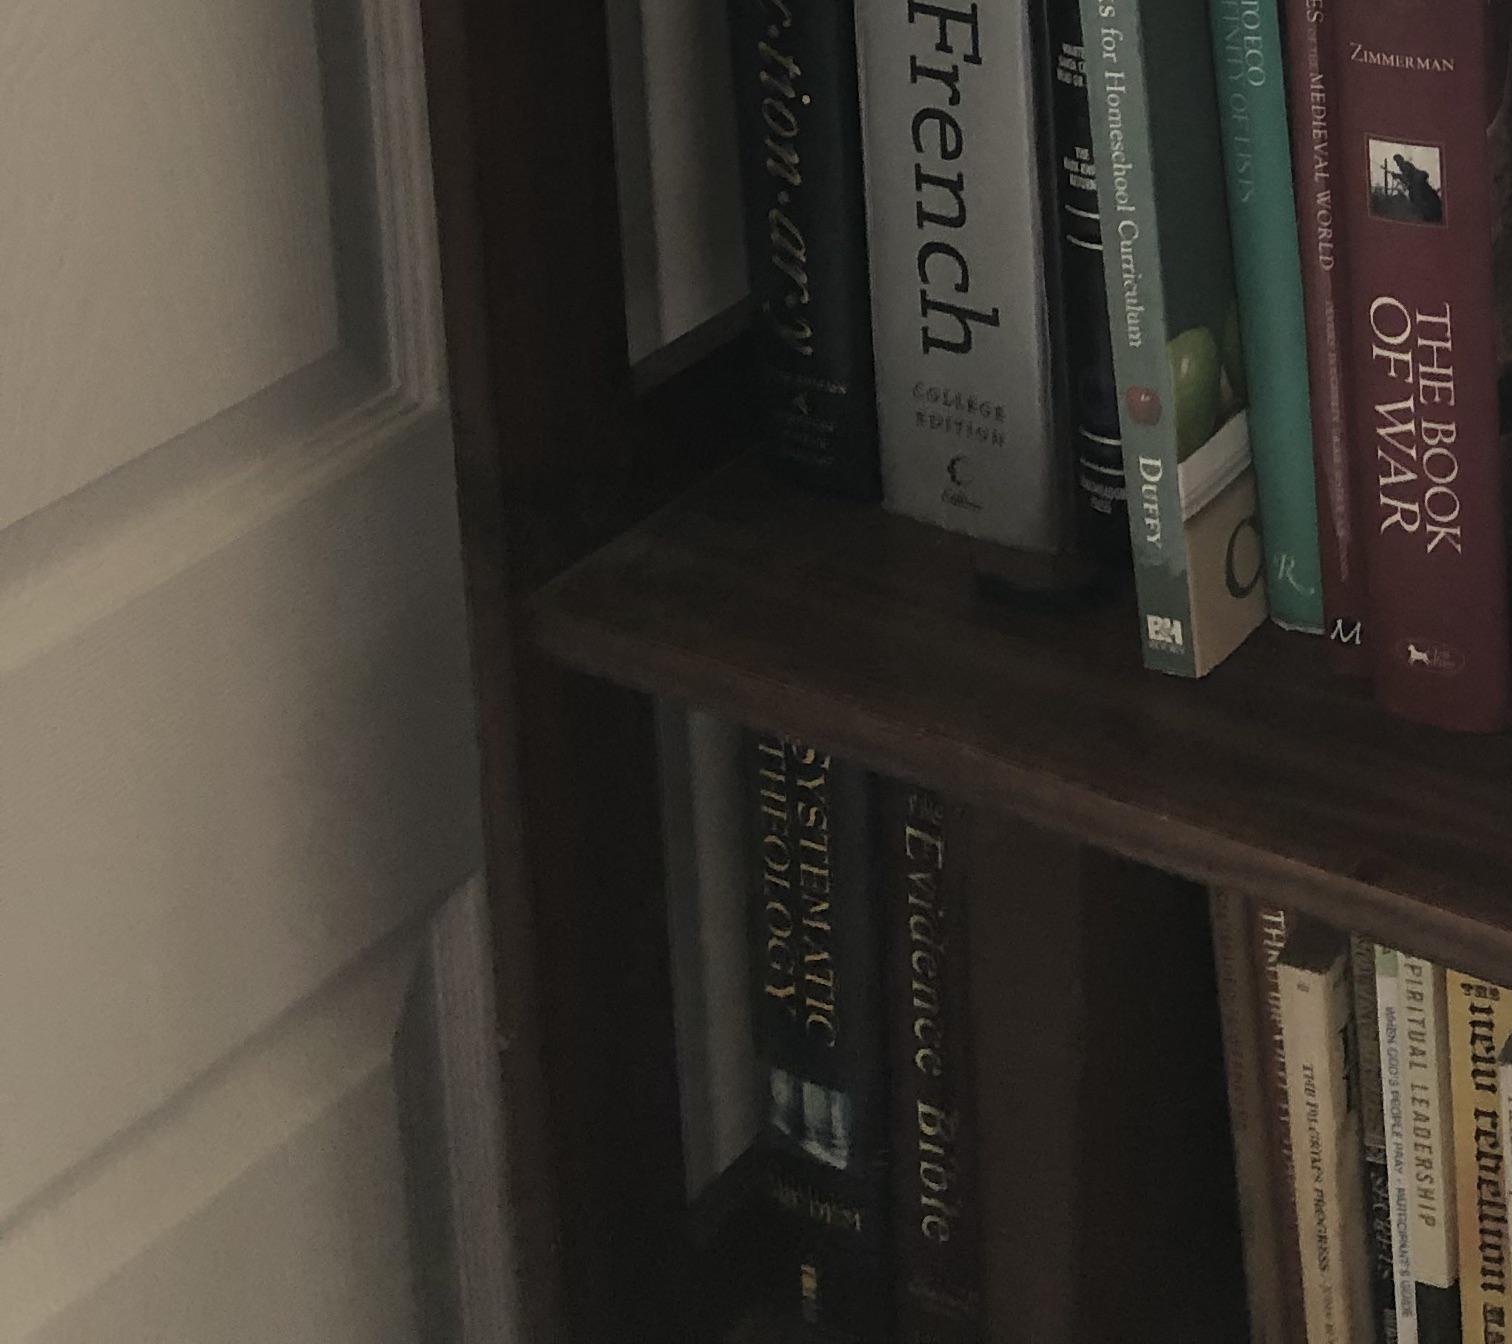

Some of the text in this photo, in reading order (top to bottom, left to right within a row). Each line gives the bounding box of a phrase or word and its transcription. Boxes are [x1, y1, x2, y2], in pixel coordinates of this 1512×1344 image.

[1101, 25, 1124, 64] for
[1227, 92, 1249, 128] OF
[1242, 35, 1266, 87] ECO
[1350, 42, 1456, 74] ZIMMERMAN
[1102, 68, 1136, 214] Homeschool
[1309, 70, 1330, 193] MEDIEVAL
[1116, 218, 1143, 349] Curriculum
[1312, 196, 1335, 273] WORLD
[1368, 295, 1422, 535] OF WAR
[1415, 302, 1462, 554] THE BOOK
[903, 821, 946, 1078] Evidence
[1403, 962, 1437, 1228] PIRITUAL LEADERSHIP
[1468, 1001, 1498, 1095] new
[917, 1098, 953, 1246] Bible
[1473, 1107, 1508, 1295] rebellion
